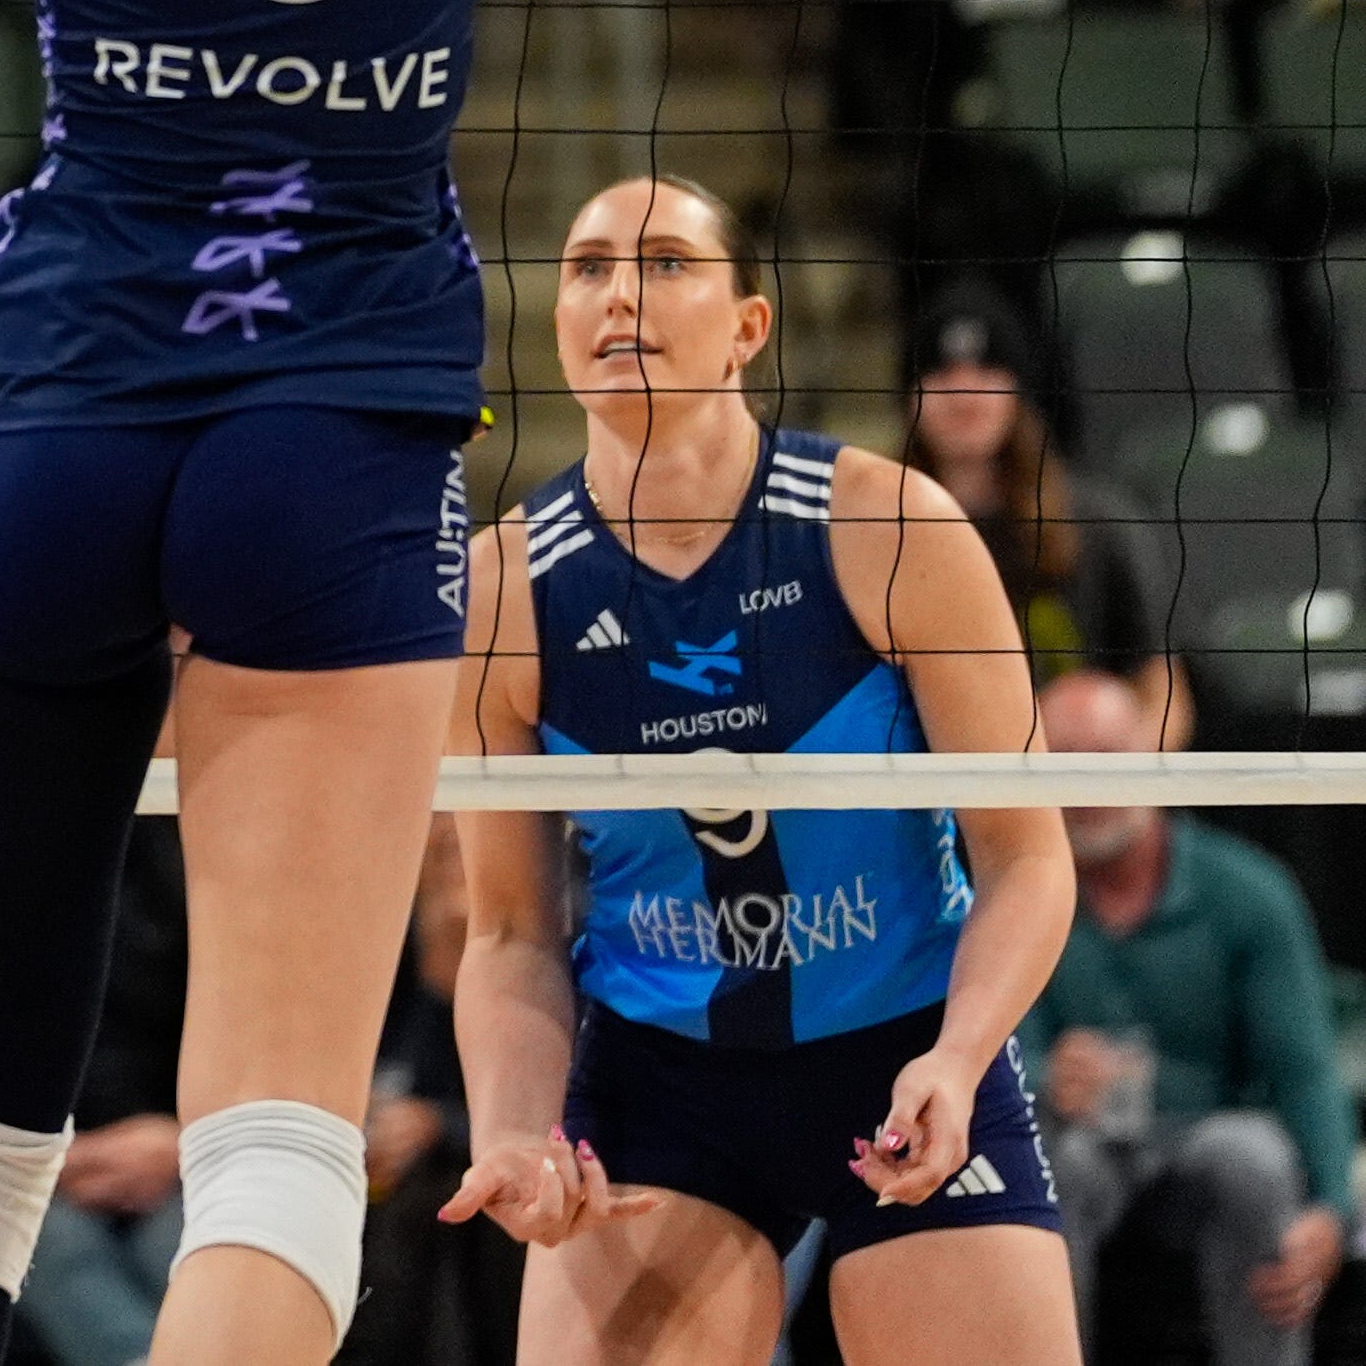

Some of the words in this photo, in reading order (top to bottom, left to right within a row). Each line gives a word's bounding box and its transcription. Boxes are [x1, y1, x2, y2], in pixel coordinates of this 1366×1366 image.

[93, 37, 451, 112] REVOLVE
[739, 580, 802, 614] LOVB
[641, 702, 767, 744] HOUSTON
[629, 874, 874, 935] MEMORIAL
[632, 899, 877, 970] HERMANN
